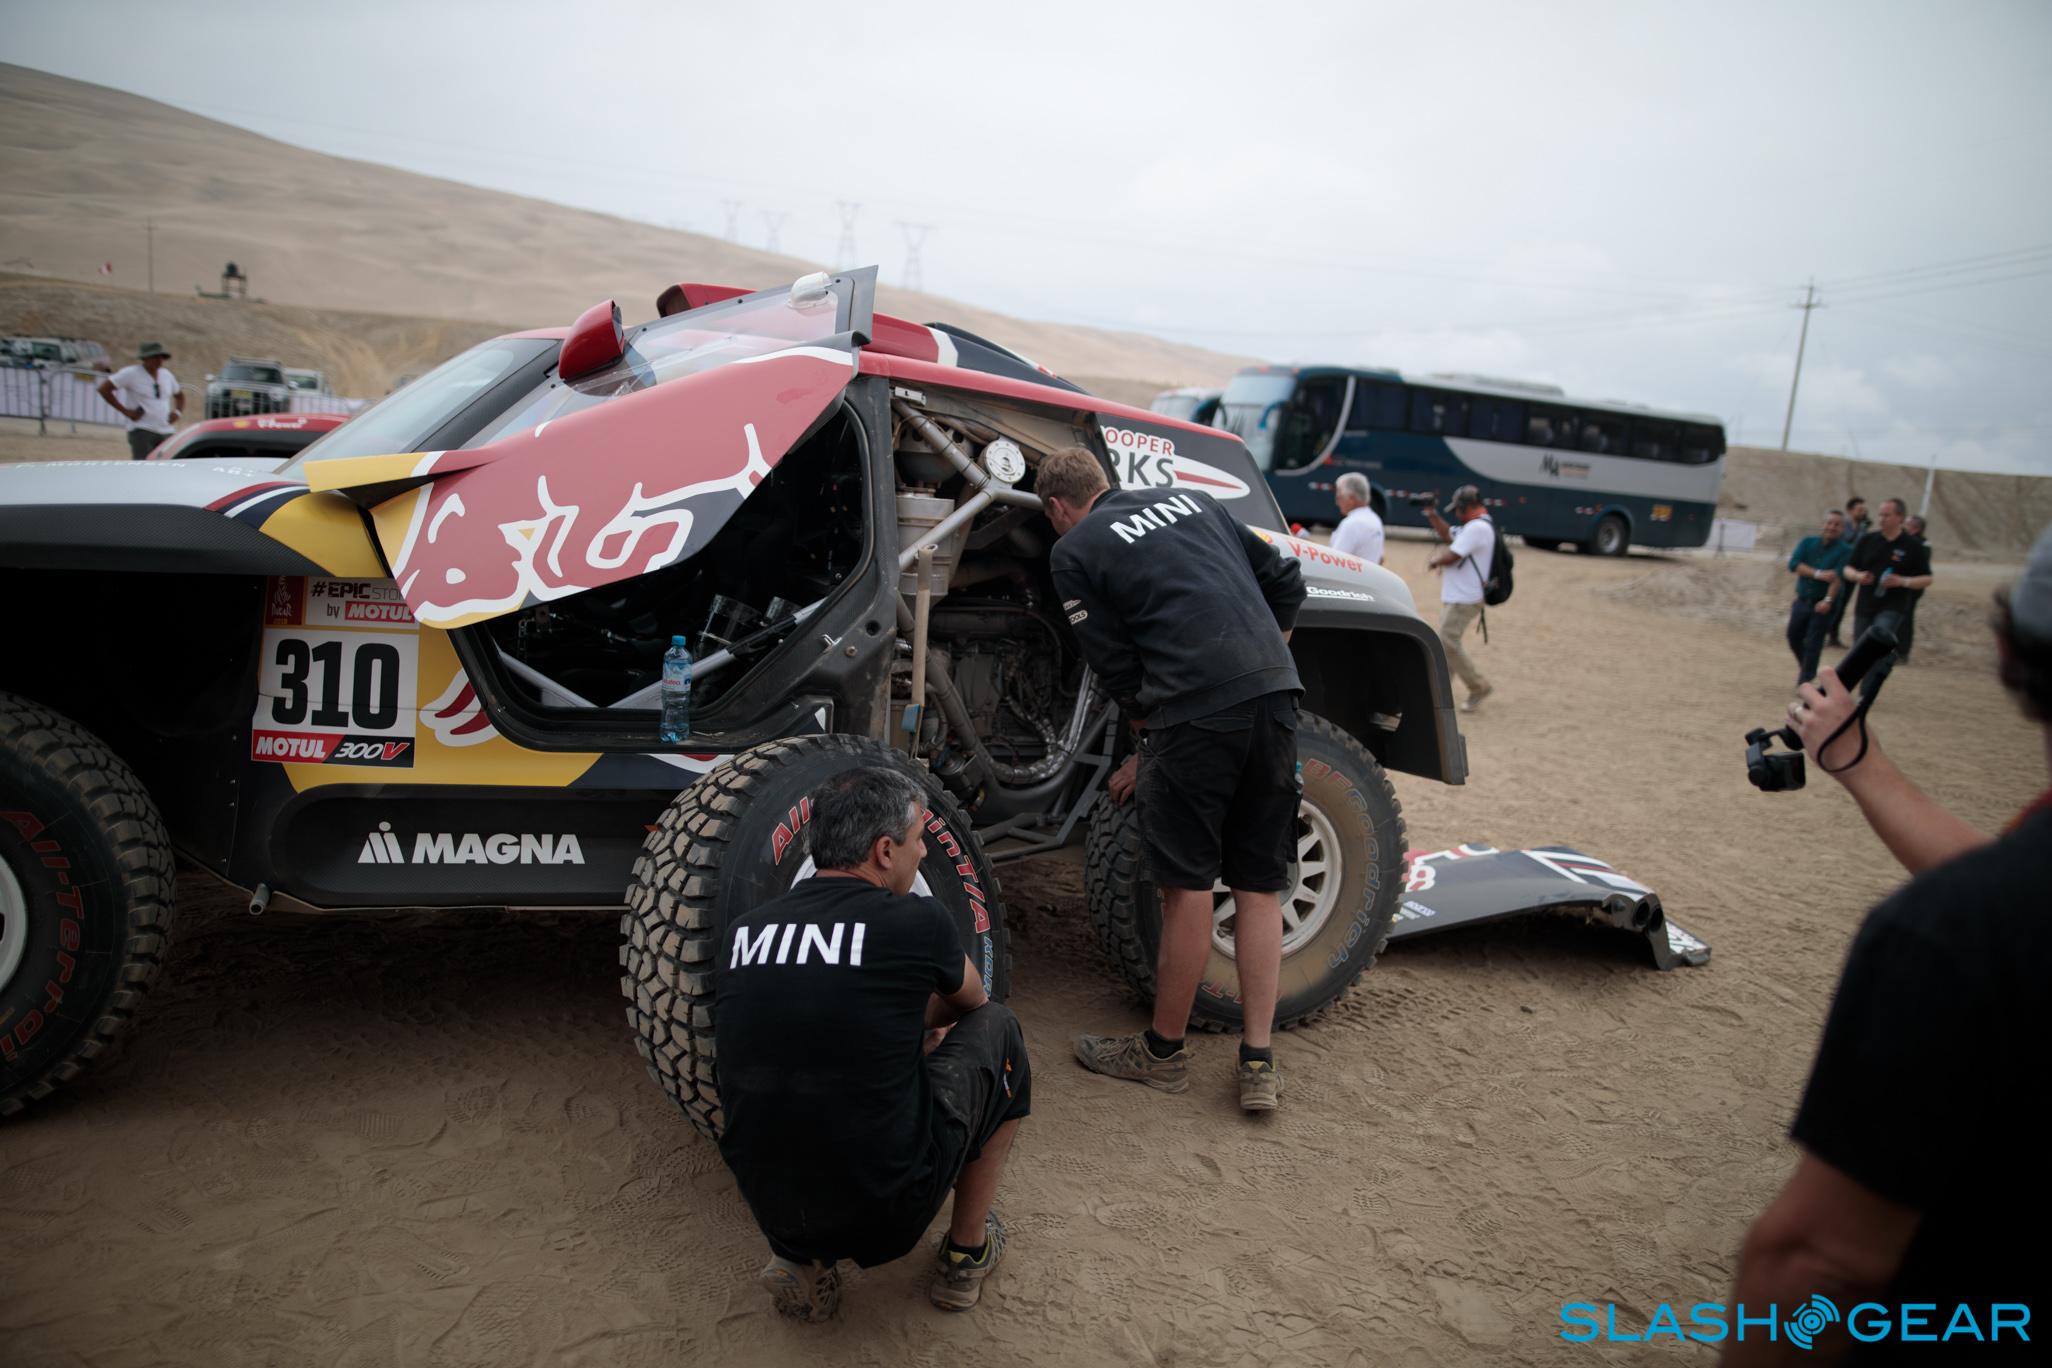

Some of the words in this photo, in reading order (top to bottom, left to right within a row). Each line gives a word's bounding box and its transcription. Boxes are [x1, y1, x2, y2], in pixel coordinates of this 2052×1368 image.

[1110, 494, 1202, 544] MINI
[1287, 540, 1363, 572] V-Power
[326, 603, 340, 619] by
[348, 604, 414, 621] MOTUL
[272, 639, 400, 729] 310
[256, 736, 326, 758] MOTUL
[335, 742, 410, 761] 300V
[412, 833, 586, 865] MAGNA
[1304, 758, 1380, 968] BFGoodrich
[956, 855, 991, 934] T/A
[729, 922, 867, 969] MINI
